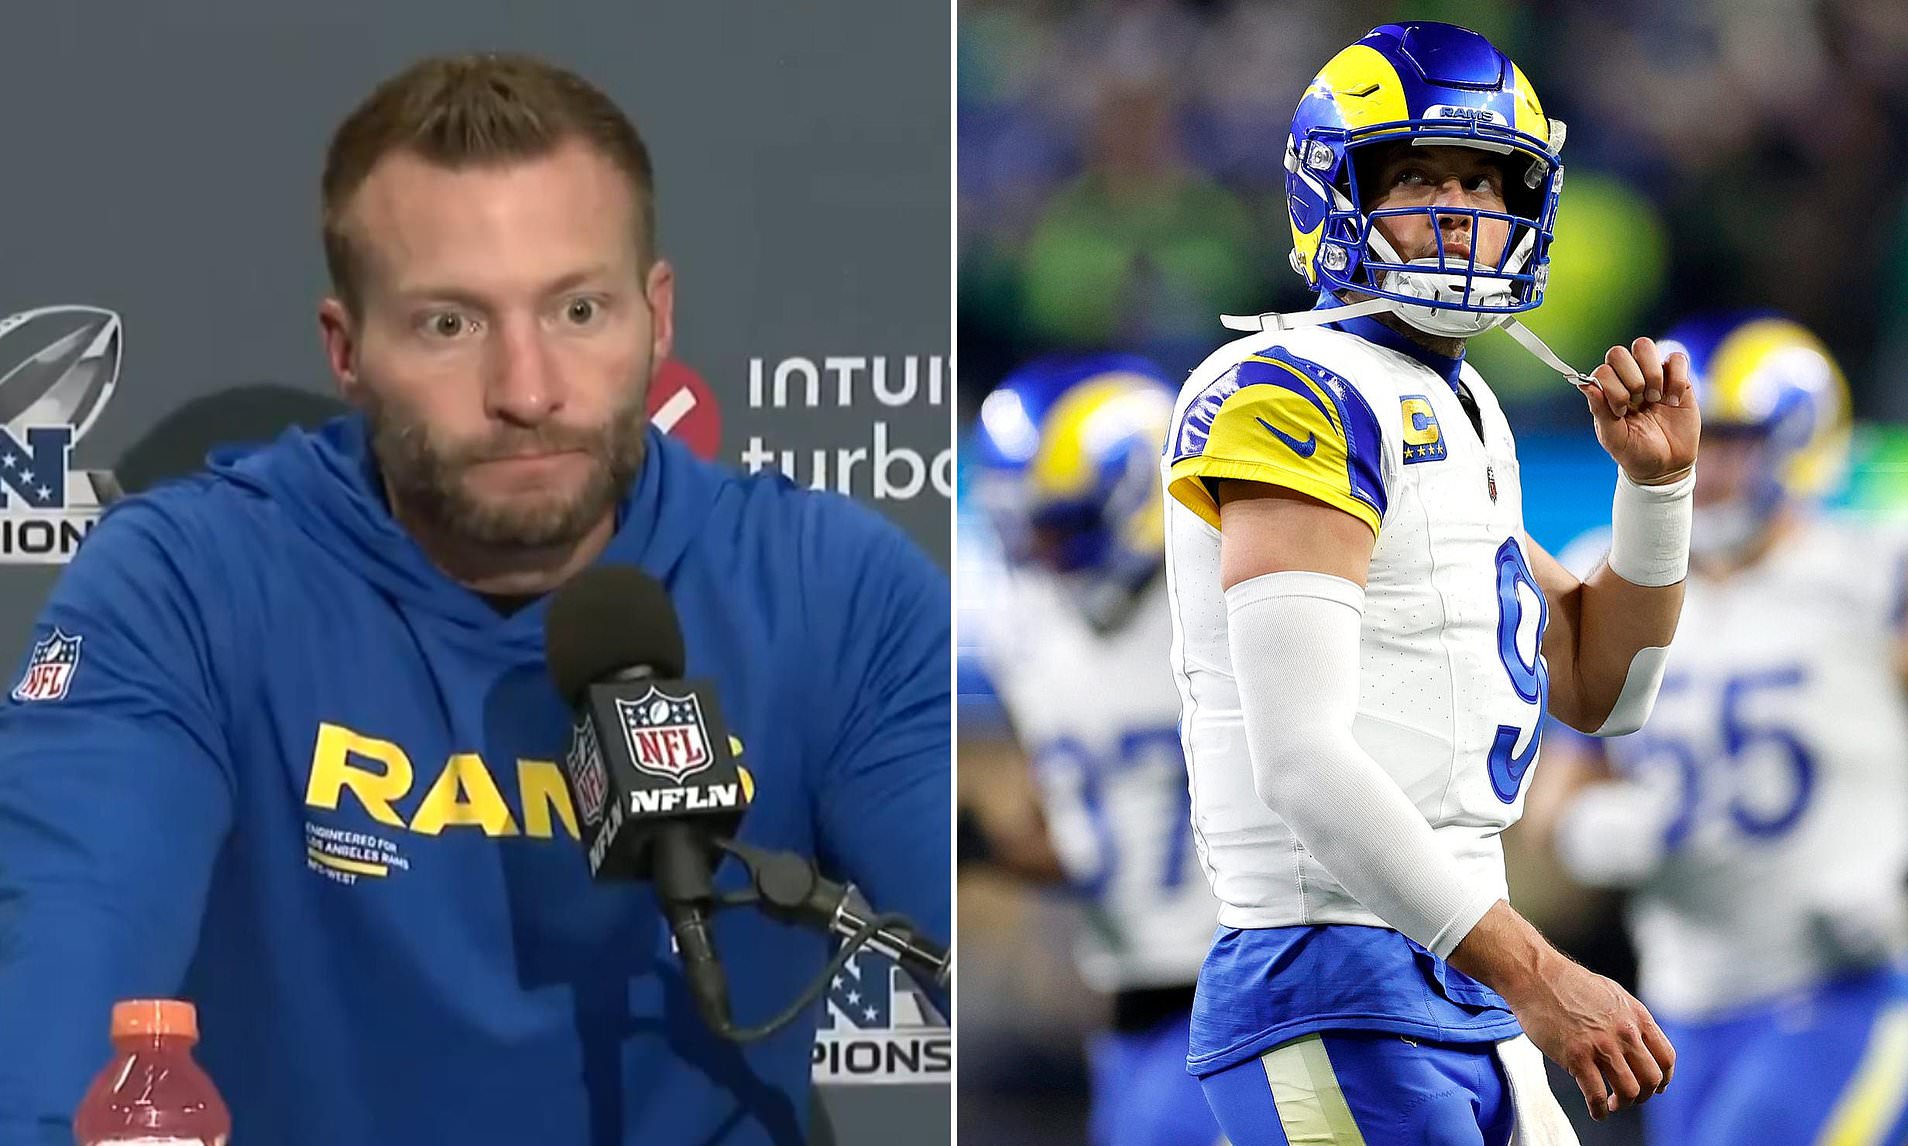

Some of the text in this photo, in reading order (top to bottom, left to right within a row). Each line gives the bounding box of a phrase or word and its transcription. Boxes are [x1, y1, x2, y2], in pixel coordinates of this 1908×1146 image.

[1439, 106, 1494, 123] RAMS
[749, 355, 951, 407] INTUI
[1402, 397, 1440, 446] C
[21, 665, 63, 697] NFL
[1487, 536, 1550, 804] 9
[635, 727, 704, 770] NFL
[630, 783, 738, 813] NFLN
[324, 842, 380, 862] ANGELES
[381, 851, 409, 870] RAMS
[377, 838, 397, 855] FOR
